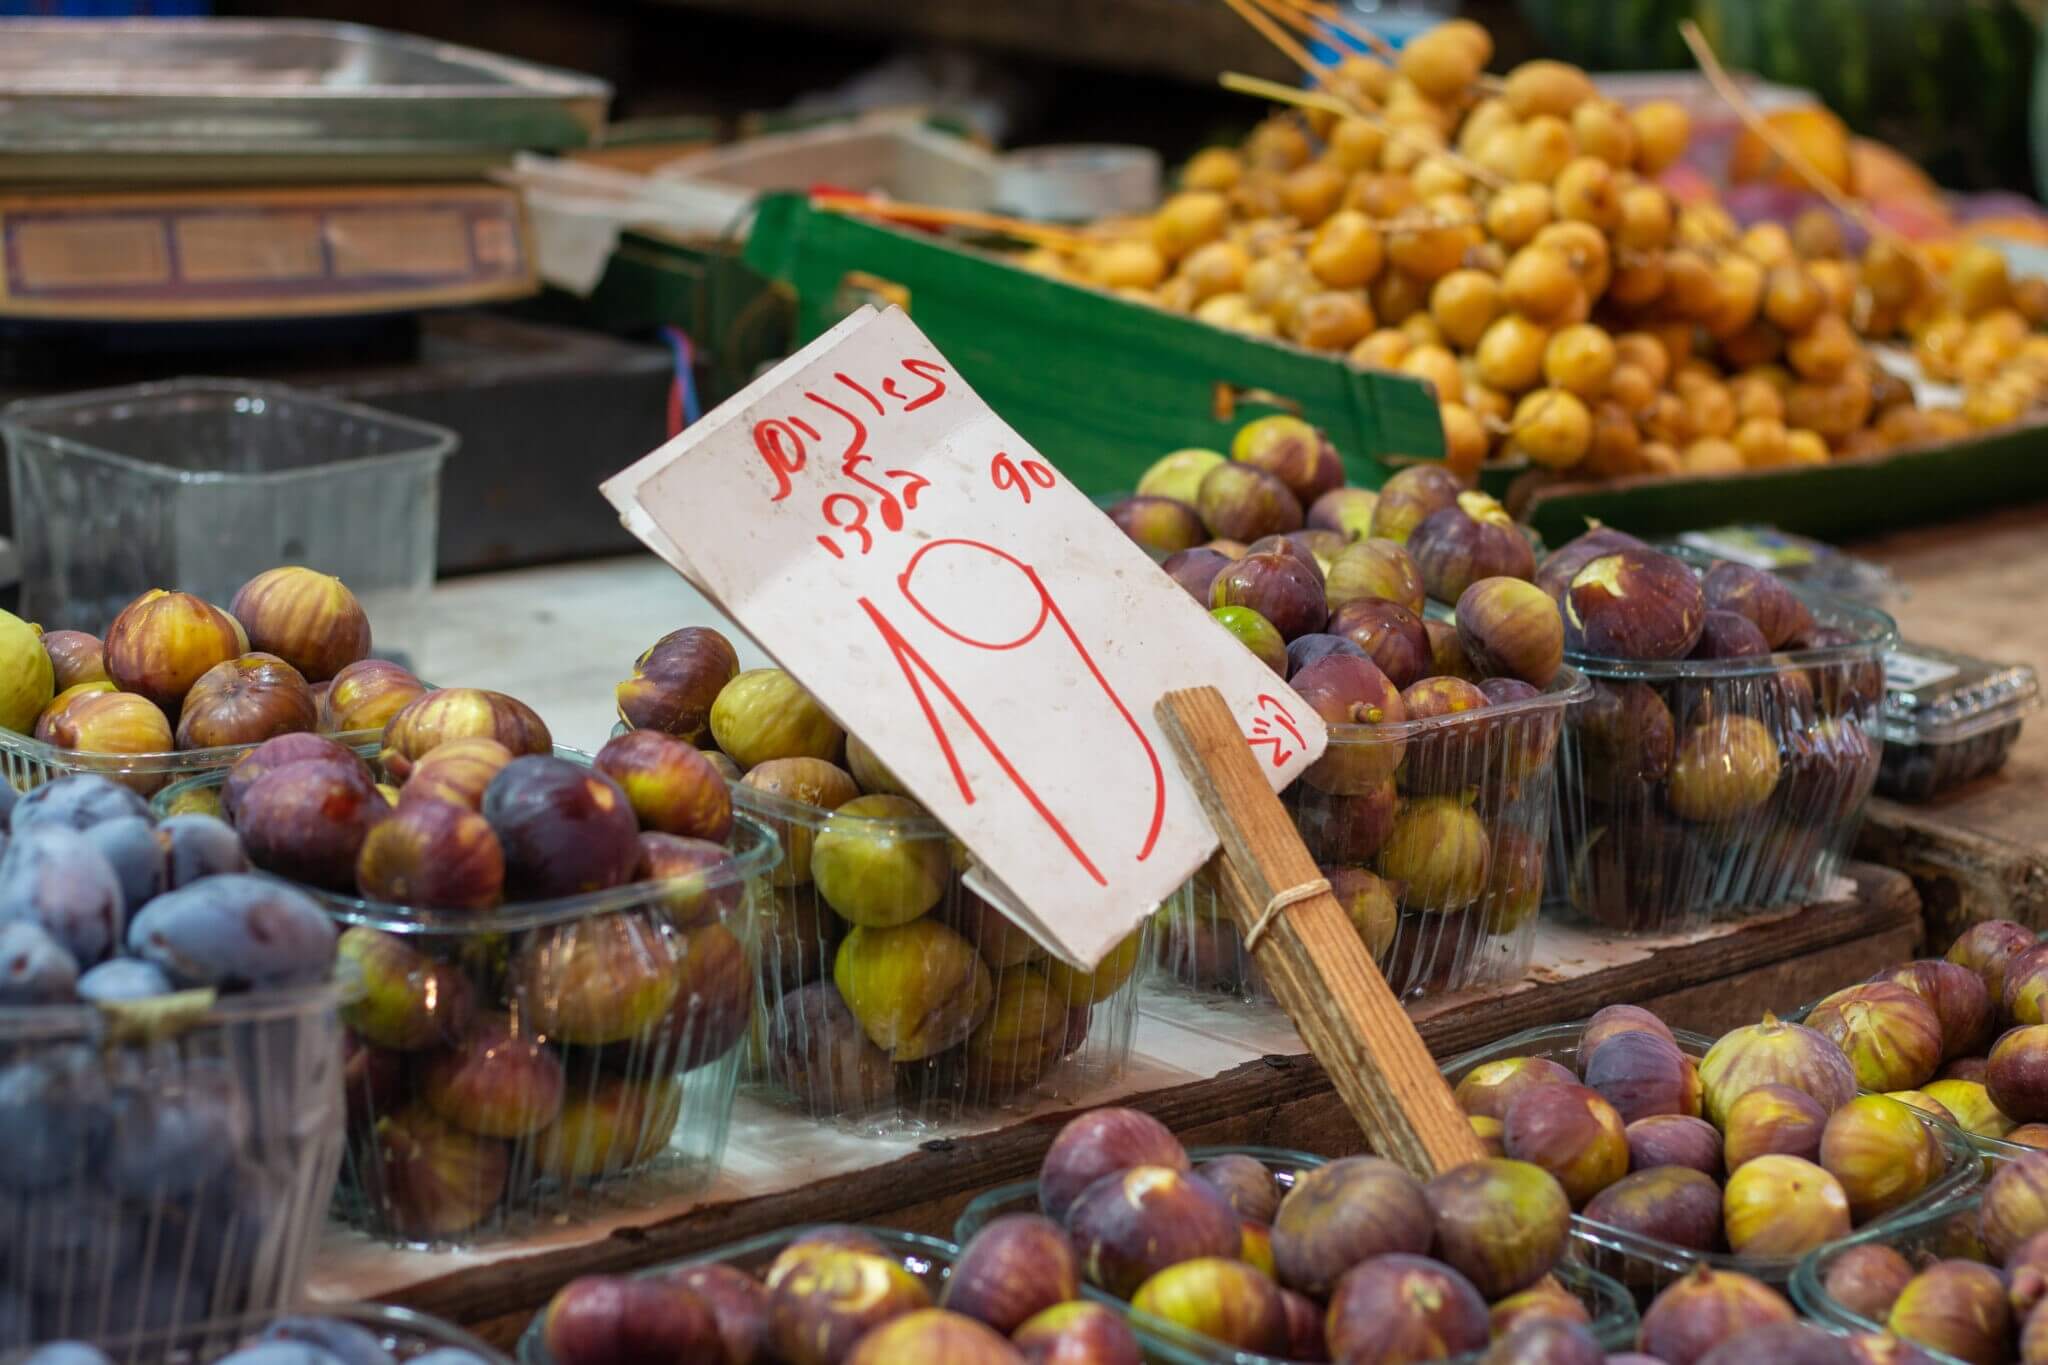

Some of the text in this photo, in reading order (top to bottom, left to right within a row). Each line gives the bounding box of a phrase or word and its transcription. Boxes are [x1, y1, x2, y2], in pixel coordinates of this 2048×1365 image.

[753, 358, 947, 502] תאנים
[990, 452, 1056, 504] 90
[815, 455, 930, 560] בלדי
[858, 538, 1168, 888] 19
